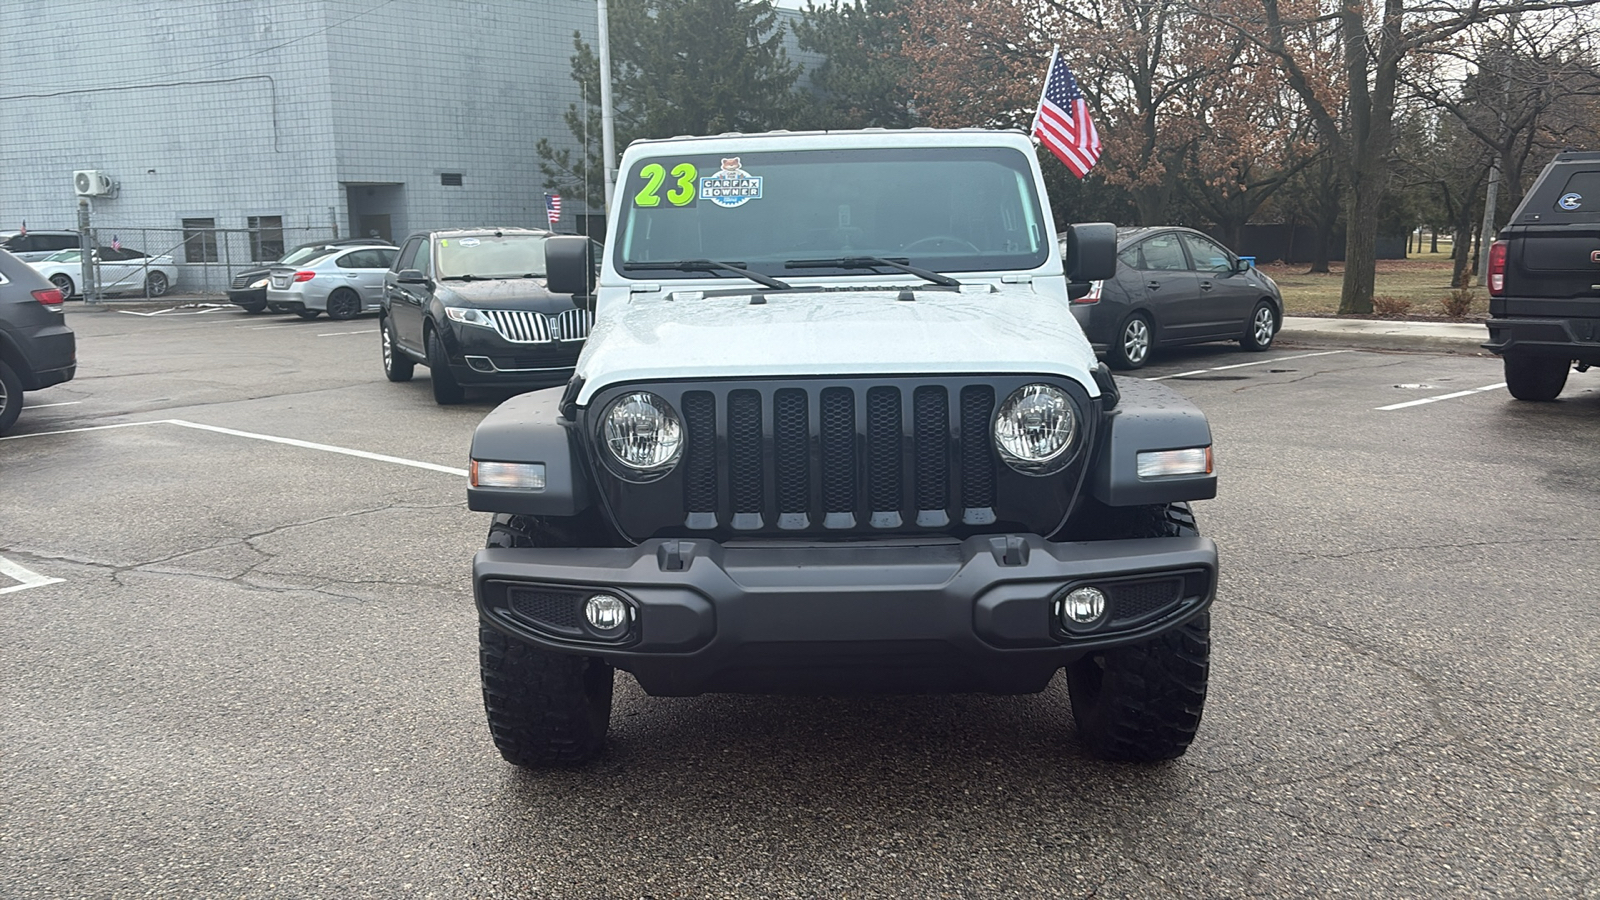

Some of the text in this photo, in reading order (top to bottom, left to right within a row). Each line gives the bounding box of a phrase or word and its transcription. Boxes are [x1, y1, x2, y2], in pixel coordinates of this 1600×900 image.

[634, 163, 698, 207] 23
[704, 180, 758, 188] CARFAX
[713, 188, 758, 196] OWNER
